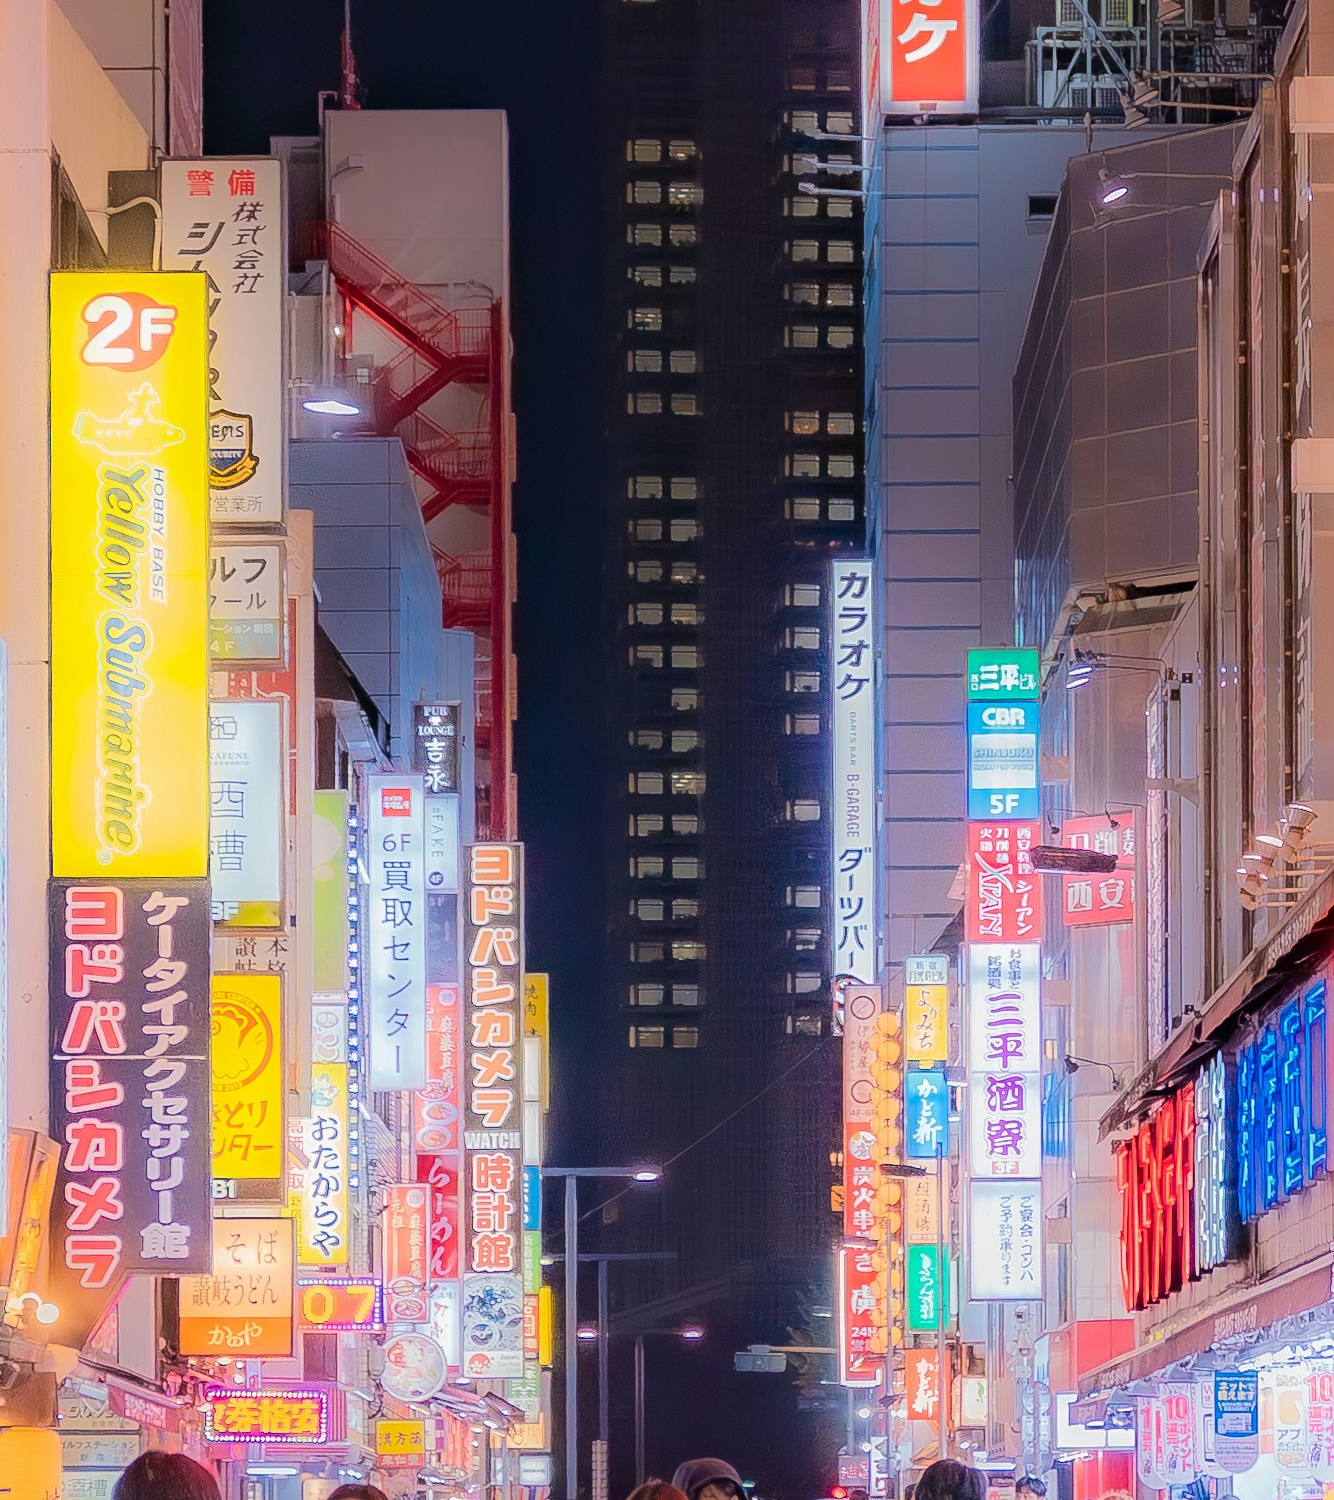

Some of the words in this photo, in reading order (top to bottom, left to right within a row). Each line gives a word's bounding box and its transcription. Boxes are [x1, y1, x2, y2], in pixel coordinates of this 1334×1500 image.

[185, 168, 257, 199] 警備
[230, 200, 265, 295] 株式会社
[79, 291, 179, 371] 2F
[152, 466, 165, 542] HOBBY
[97, 462, 150, 613] Yellow
[151, 544, 166, 605] BASE
[836, 571, 871, 702] カラオケ
[97, 611, 154, 858] Submarine
[417, 723, 455, 737] LOUNGE
[422, 705, 449, 717] PUB
[981, 707, 1026, 727] CBR
[849, 747, 857, 767] BAR
[846, 773, 860, 839] B-GARAGE
[989, 793, 1020, 815] 5F
[382, 833, 412, 853] 6F
[837, 847, 872, 972] ダーツバー
[1015, 879, 1034, 936] シーアン
[380, 860, 414, 1075] 買取センター
[468, 845, 519, 1129] ヨドバシカメラ
[61, 885, 127, 1290] ヨドバシカメラ
[140, 890, 191, 1261] ケータイアクセサリー館
[464, 1131, 521, 1150] WATCH
[212, 1180, 237, 1199] B1
[310, 1114, 344, 1258] おたからや
[427, 1157, 457, 1277] らーめん
[471, 1154, 515, 1272] 時計館
[225, 1230, 280, 1266] そば
[190, 1274, 280, 1308] 讃岐うどん
[208, 1321, 264, 1347] かのや
